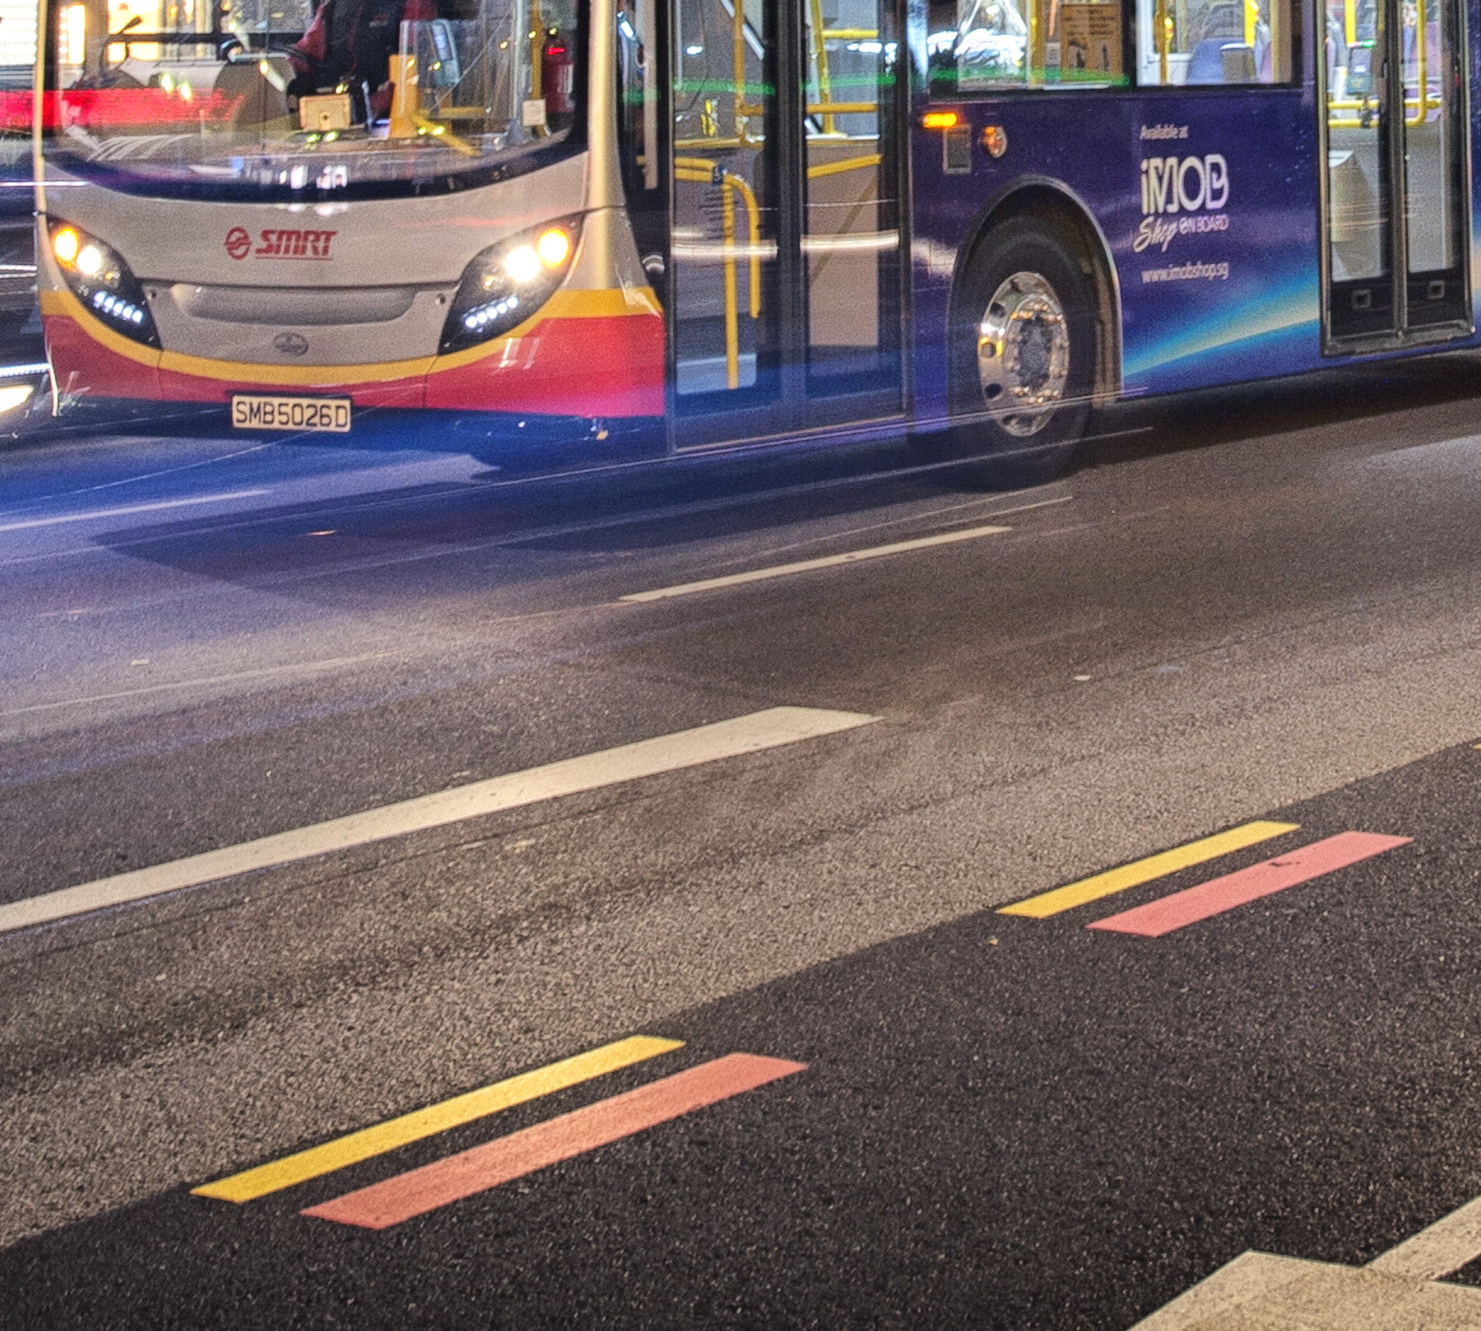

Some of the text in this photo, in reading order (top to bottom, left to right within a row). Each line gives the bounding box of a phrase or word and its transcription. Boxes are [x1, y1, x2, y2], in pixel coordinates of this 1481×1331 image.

[255, 228, 339, 257] SMRT
[1132, 215, 1178, 253] Shop
[1197, 214, 1230, 233] BOARD
[235, 400, 348, 428] SMB5026D
